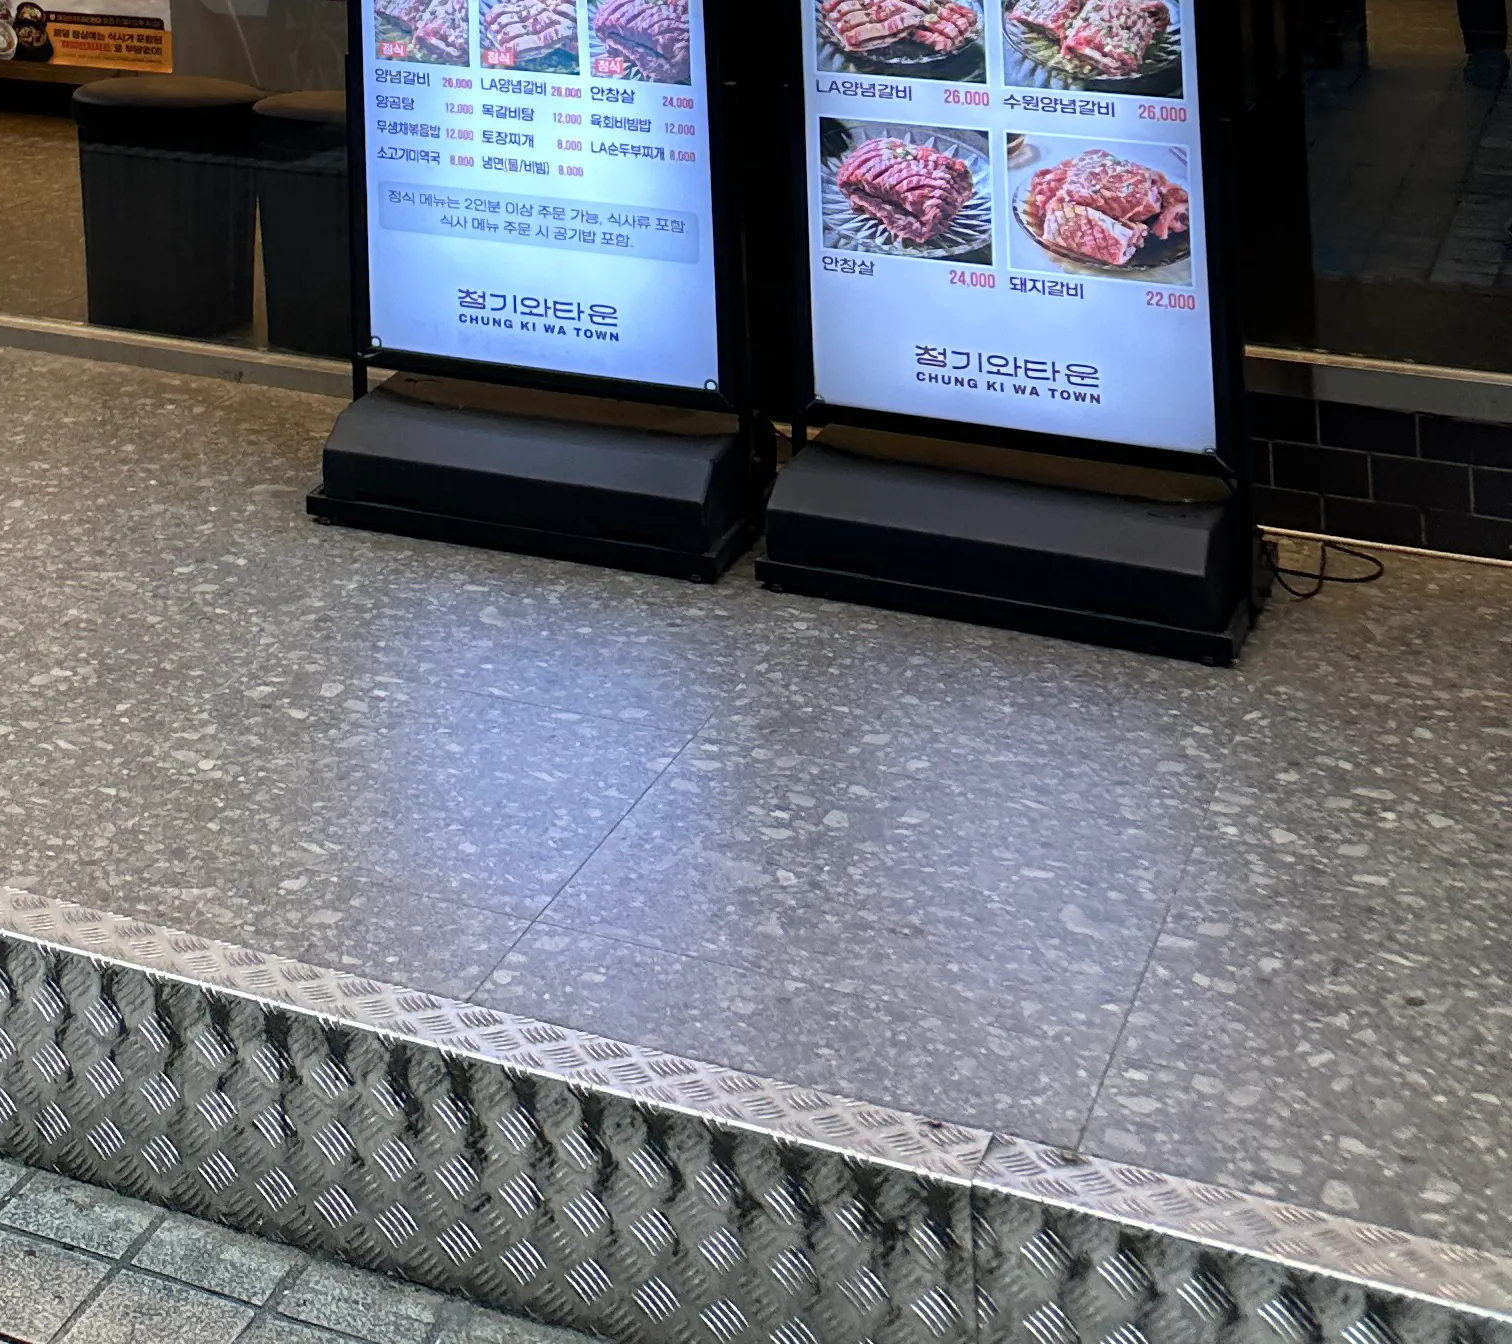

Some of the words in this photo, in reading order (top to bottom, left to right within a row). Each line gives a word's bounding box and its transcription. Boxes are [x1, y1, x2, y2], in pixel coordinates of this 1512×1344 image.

[375, 68, 430, 87] 양념갈비
[481, 78, 546, 96] LA양념갈비
[590, 86, 635, 104] 안창살
[815, 80, 912, 101] LA양념갈비
[944, 89, 989, 107] 26,000
[590, 114, 651, 132] 육회비빔밥
[1003, 94, 1115, 117] 수원양념갈비
[1138, 104, 1187, 123] 26,000
[377, 120, 440, 138] 무생채볶음밥
[377, 146, 440, 165] 소고기미역국
[591, 141, 665, 161] LA순두부찌개
[388, 190, 415, 205] 정식
[419, 194, 460, 209] 메뉴는
[464, 197, 501, 214] 2인분
[505, 201, 534, 217] 이상
[538, 205, 566, 220] 주문
[607, 213, 651, 230] 식사류
[440, 214, 468, 229] 식사
[472, 218, 500, 233] 메뉴
[503, 221, 531, 237] 주문
[535, 224, 549, 239] 시
[554, 227, 596, 244] 공기밥
[821, 255, 875, 276] 안창살
[949, 270, 995, 289] 24,000
[458, 288, 618, 327] 청기와타운
[1009, 277, 1085, 300] 돼지갈비
[1146, 291, 1196, 310] 22,000
[459, 313, 514, 329] CHUNG
[520, 321, 536, 332] KI
[544, 324, 567, 336] WA
[575, 327, 620, 342] TOWN
[915, 345, 1099, 388] 청기와타운
[916, 371, 978, 389] CHUNG
[986, 380, 1005, 392] KI
[1013, 384, 1040, 398] WA
[1048, 388, 1101, 404] TOWN
